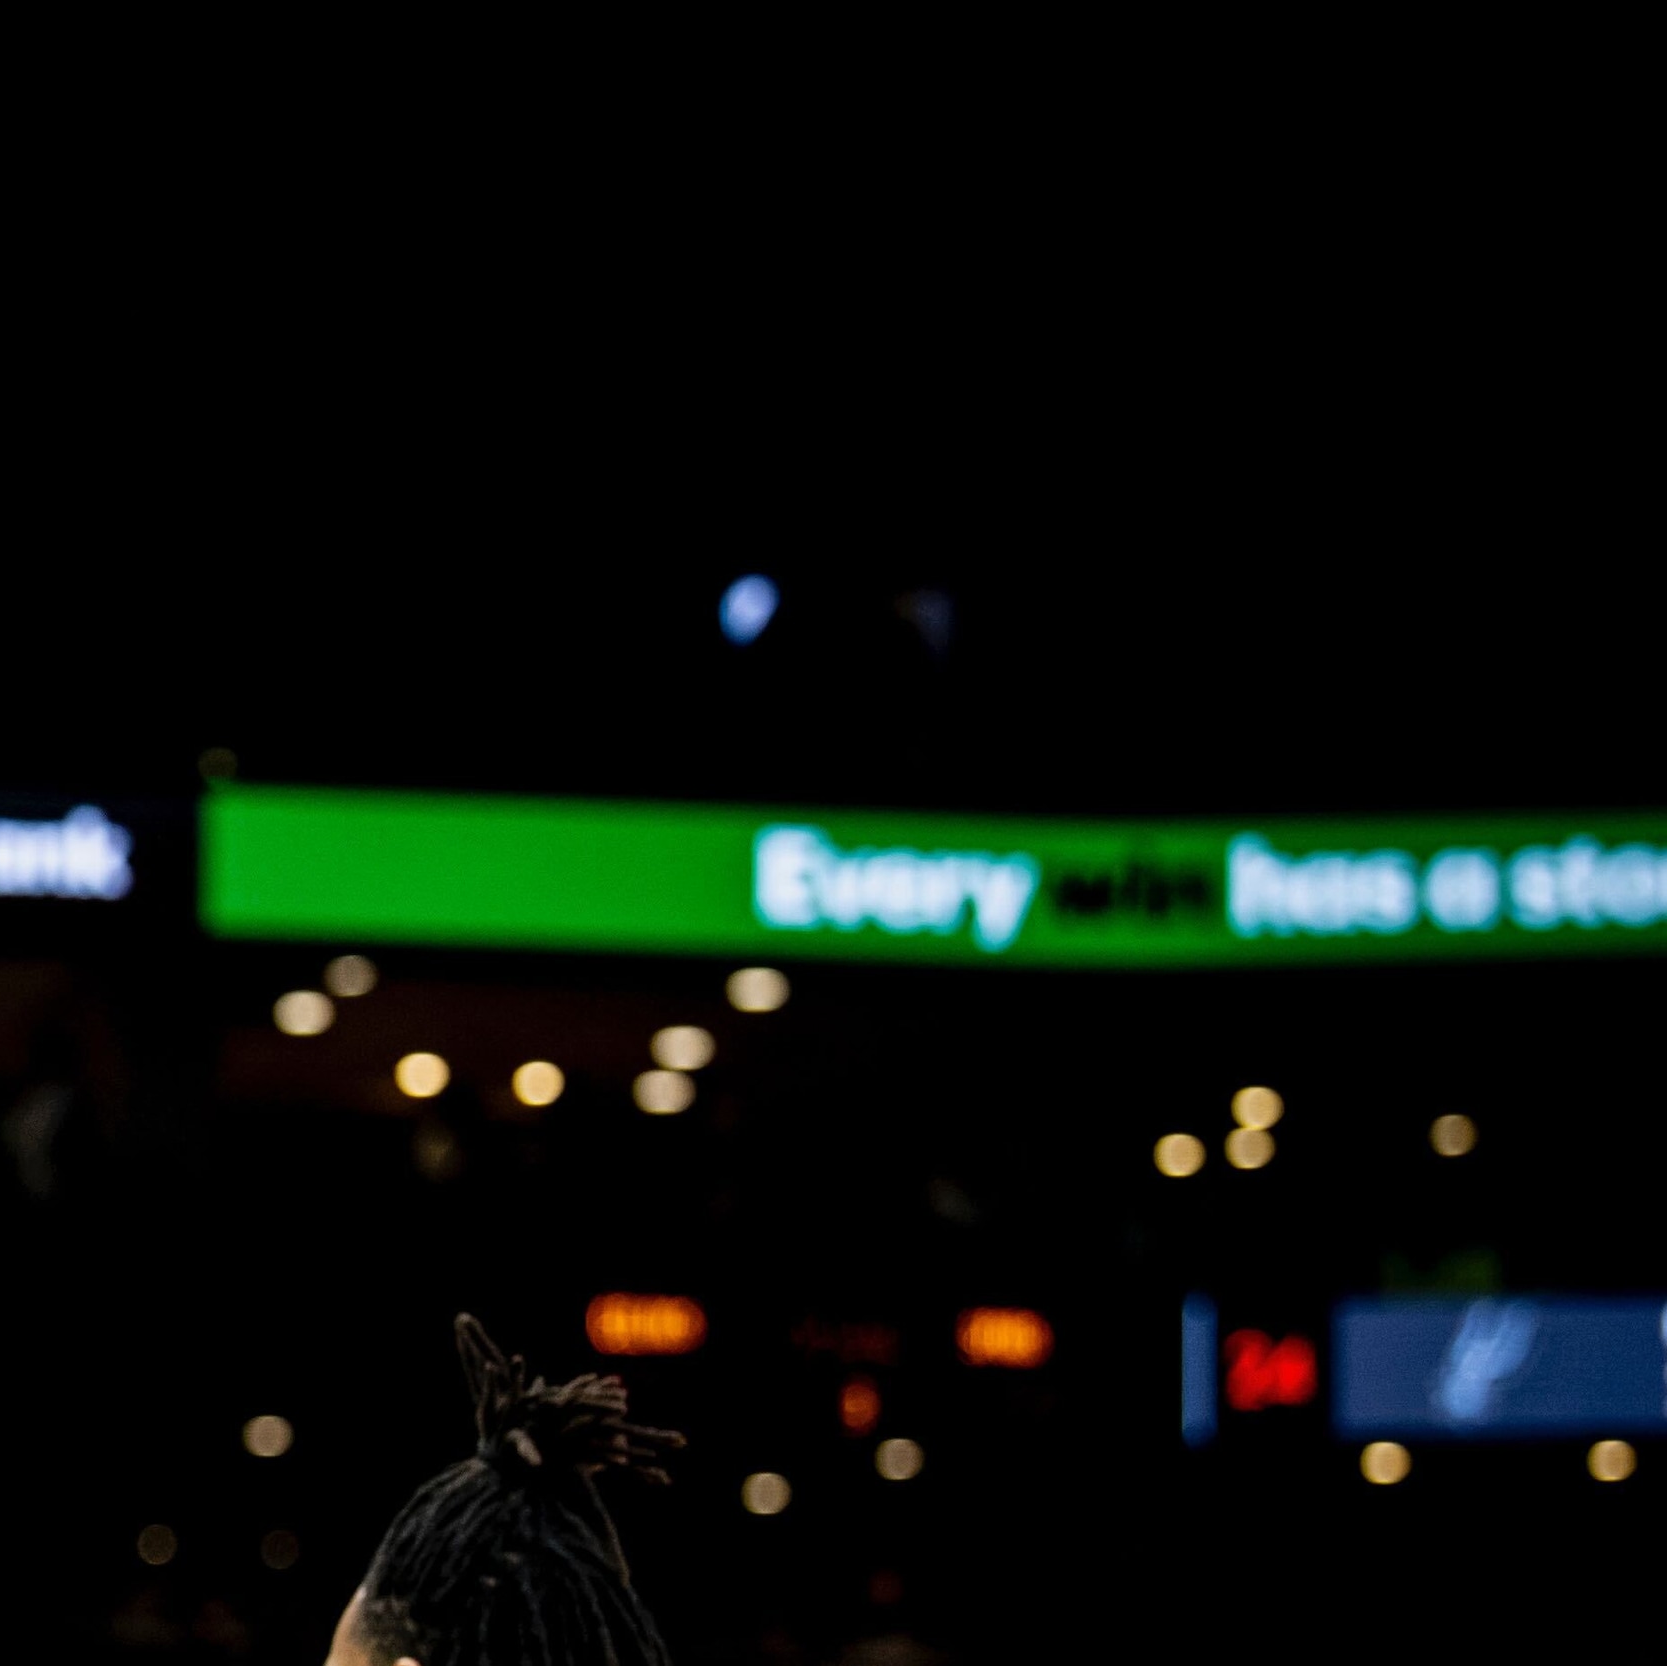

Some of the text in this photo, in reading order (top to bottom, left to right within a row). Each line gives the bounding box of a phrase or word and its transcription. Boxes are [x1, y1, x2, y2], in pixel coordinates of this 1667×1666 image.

[752, 824, 1041, 952] Every
[1227, 831, 1419, 938] has
[1421, 846, 1503, 934] a
[1509, 834, 1667, 932] sto
